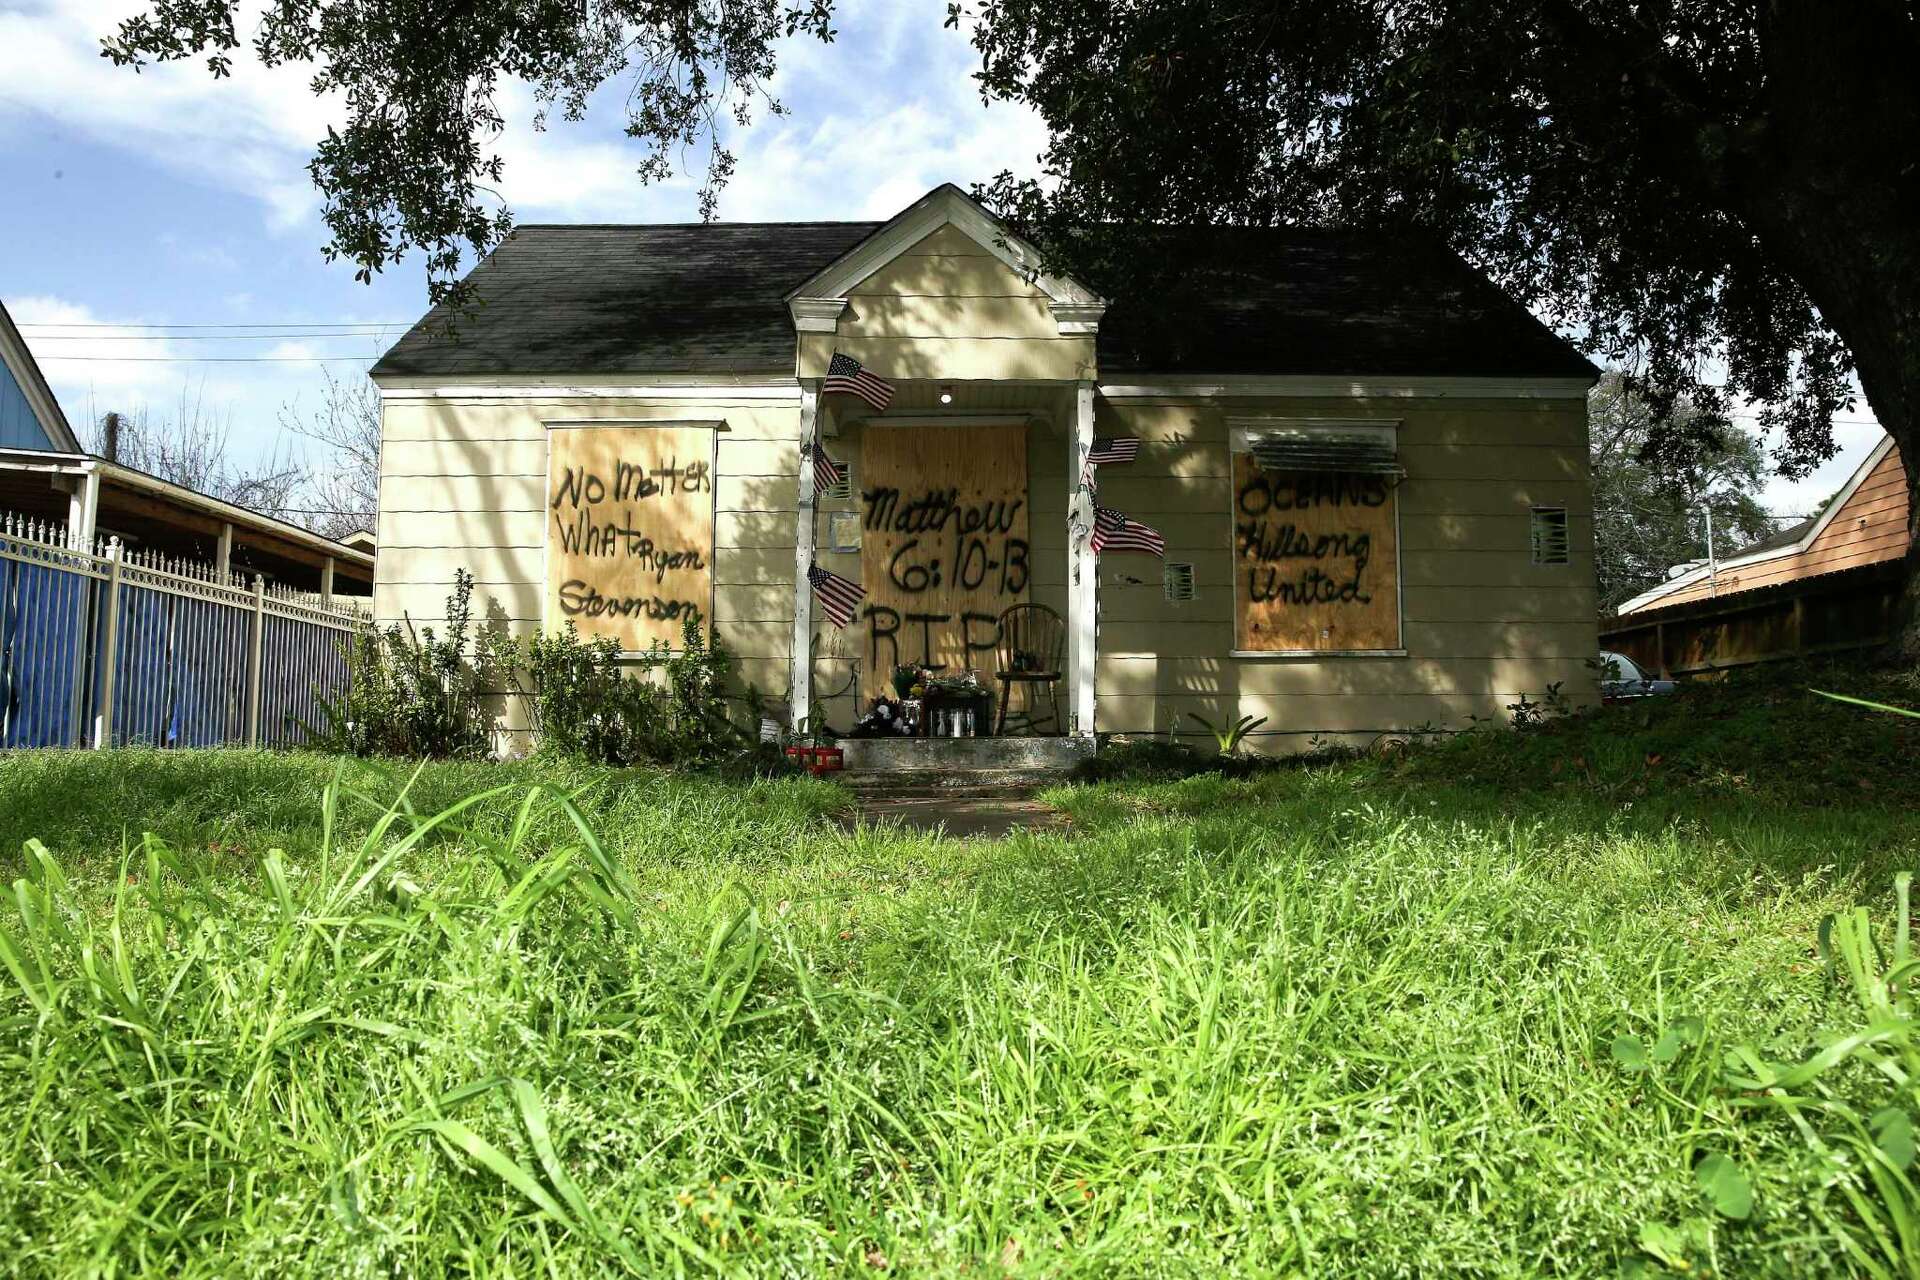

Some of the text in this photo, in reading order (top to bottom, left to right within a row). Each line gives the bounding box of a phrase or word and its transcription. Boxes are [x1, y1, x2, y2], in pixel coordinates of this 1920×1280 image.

[862, 487, 1023, 534] Matthew
[559, 579, 704, 621] Stevenson
[1250, 564, 1371, 605] United
